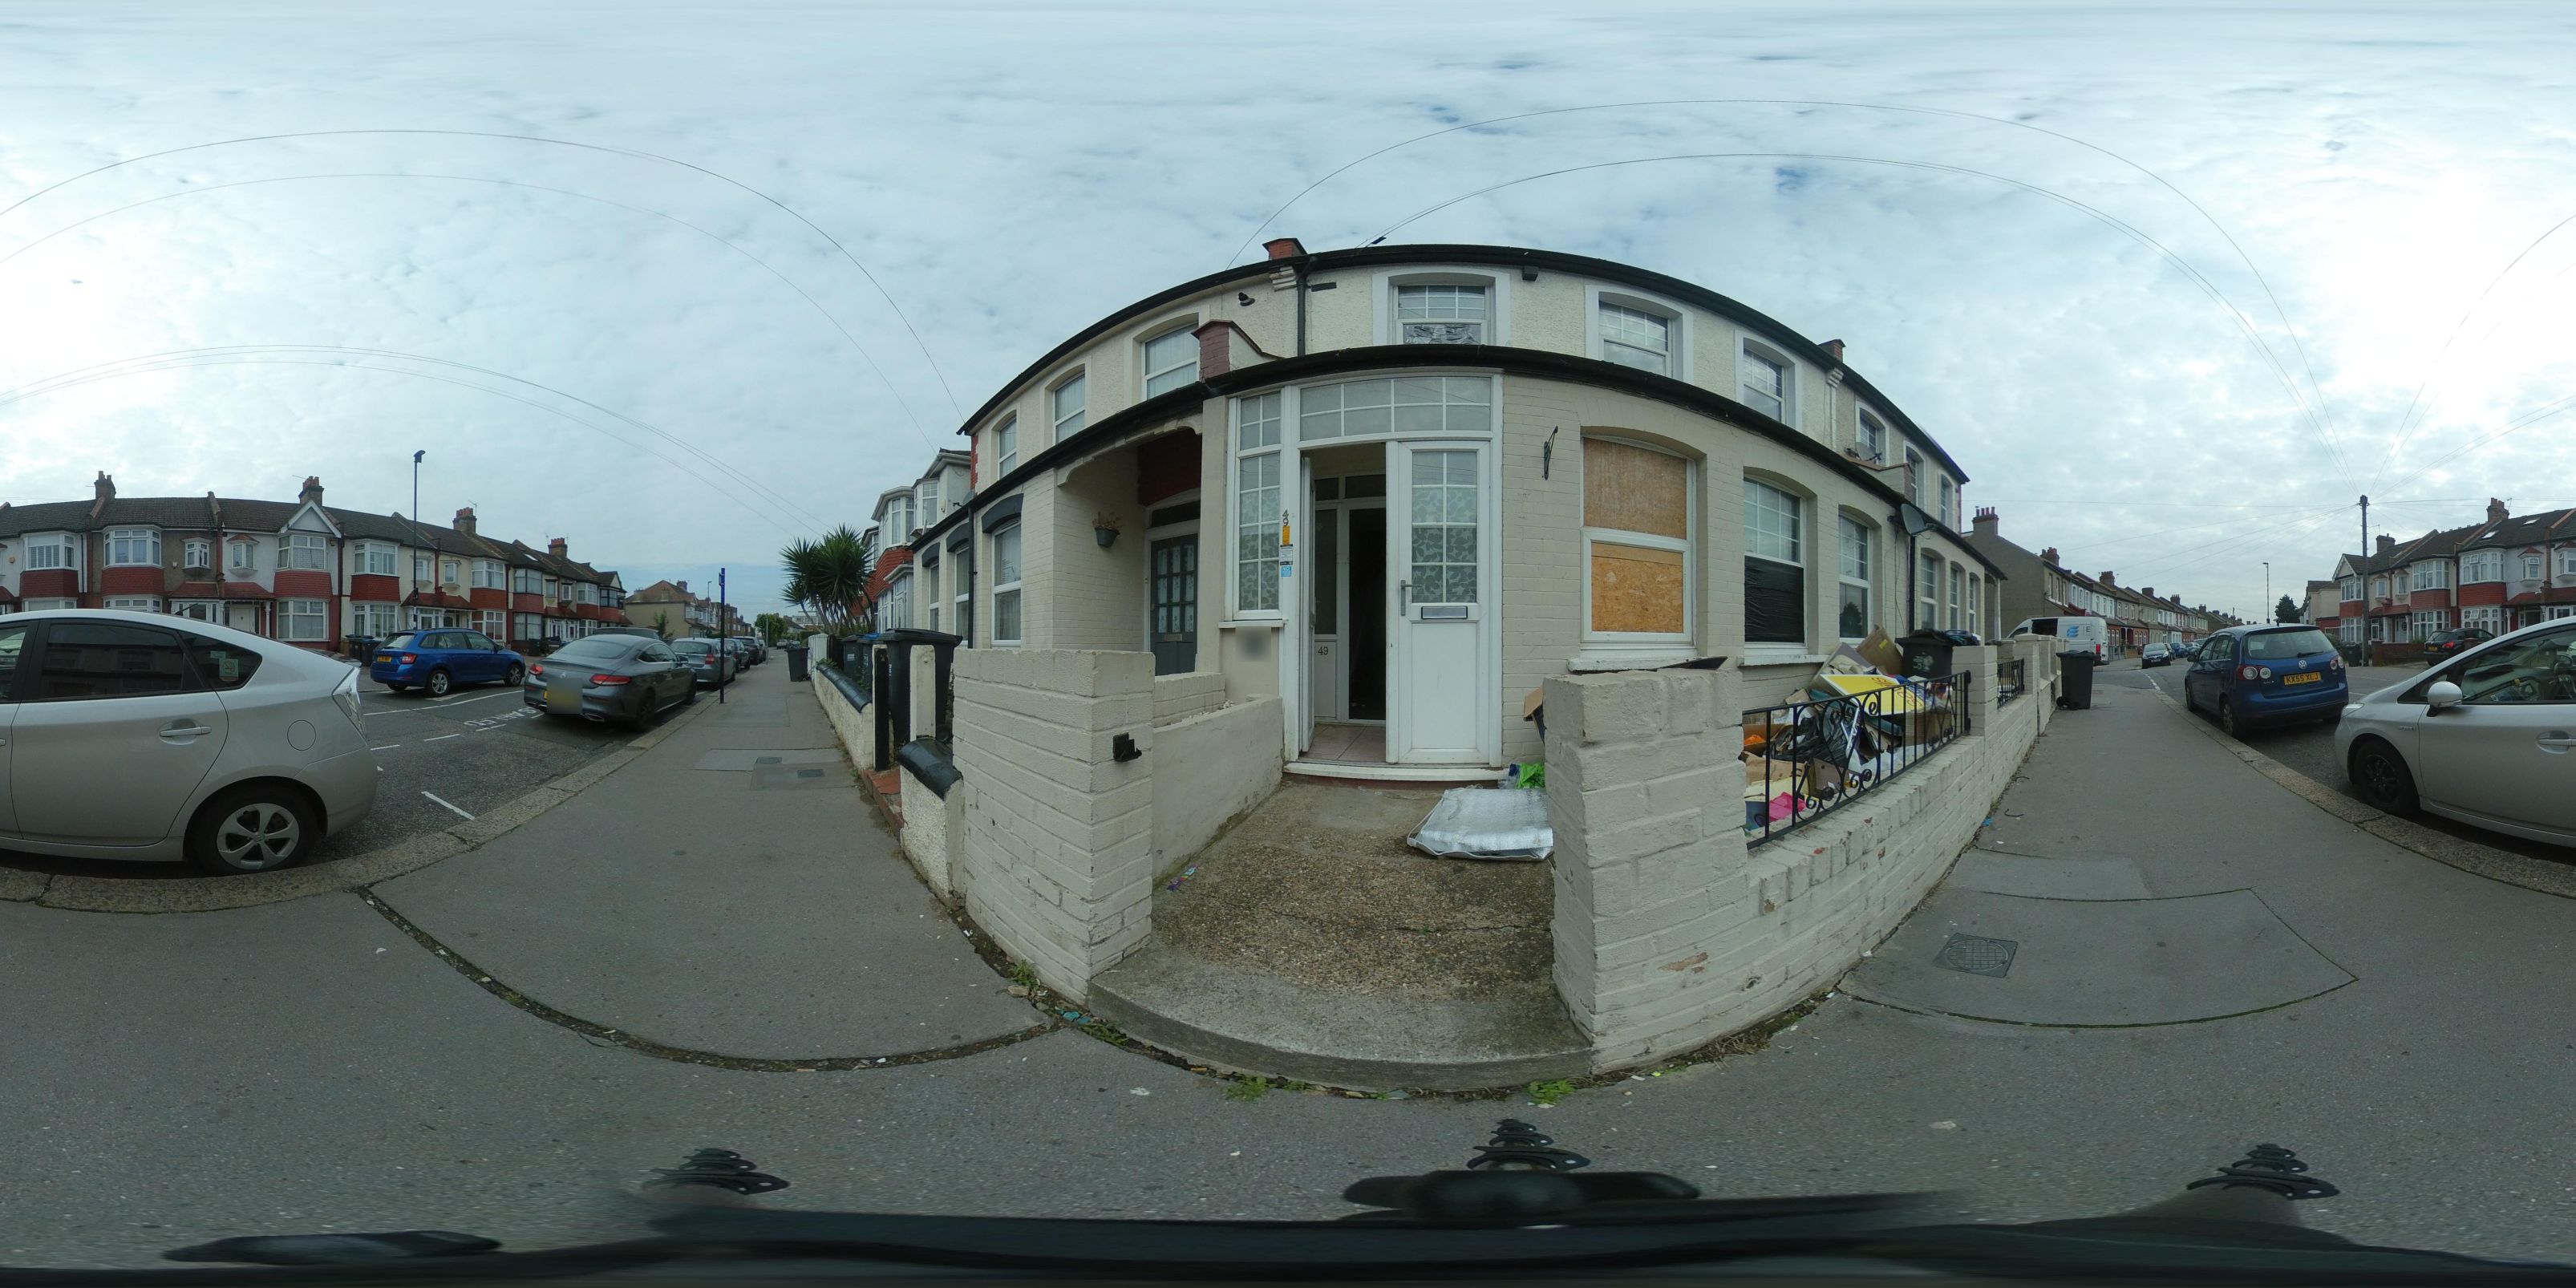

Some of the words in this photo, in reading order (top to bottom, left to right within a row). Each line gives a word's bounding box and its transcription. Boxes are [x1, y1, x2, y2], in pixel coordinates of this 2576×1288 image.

[1318, 646, 1328, 655] 49
[2286, 674, 2304, 683] KX55
[2306, 673, 2319, 681] XLJ
